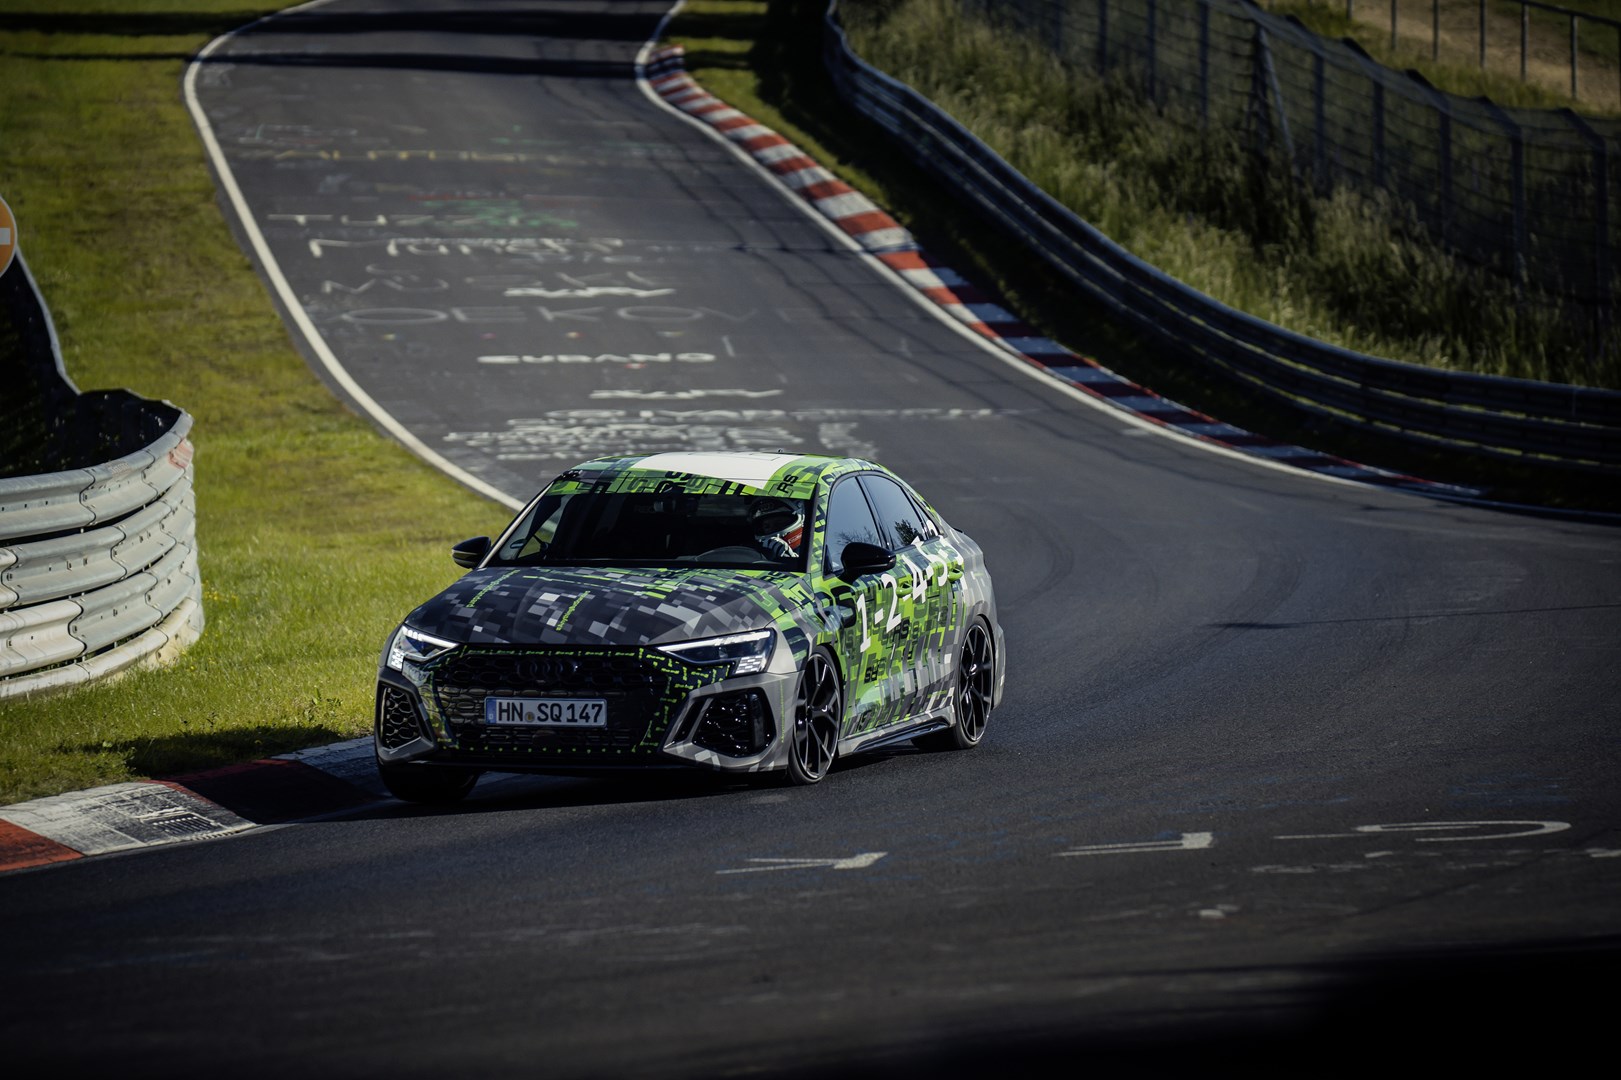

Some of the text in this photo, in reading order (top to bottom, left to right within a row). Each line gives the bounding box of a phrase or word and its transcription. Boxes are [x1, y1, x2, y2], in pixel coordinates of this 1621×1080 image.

[776, 474, 799, 494] RS
[498, 702, 523, 721] HN
[537, 703, 562, 722] SQ
[566, 703, 603, 723] 147
